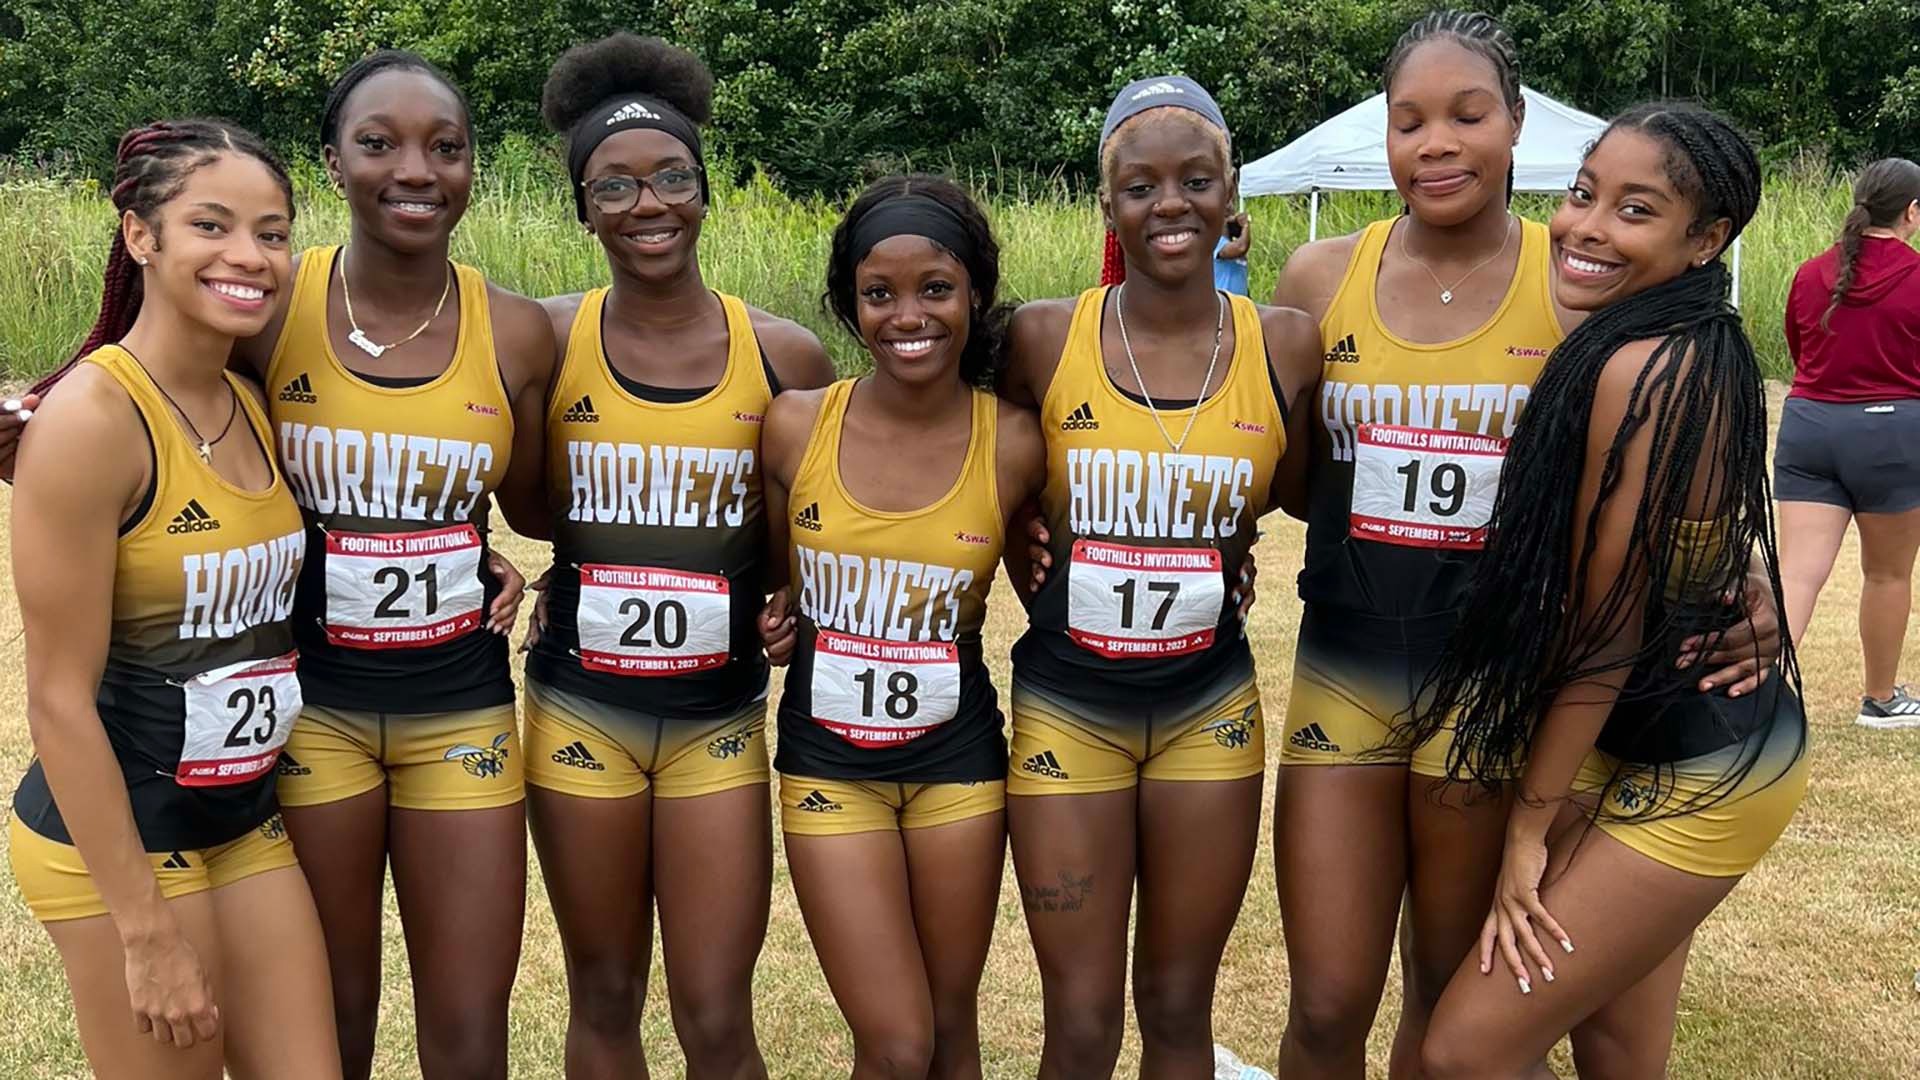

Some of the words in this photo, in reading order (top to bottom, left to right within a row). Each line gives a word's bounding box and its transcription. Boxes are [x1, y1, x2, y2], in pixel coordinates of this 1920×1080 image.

[1325, 351, 1360, 363] adidas
[1516, 348, 1547, 357] SWAC
[279, 391, 317, 404] adidas
[474, 404, 500, 417] SWAC
[562, 412, 600, 424] adidas
[1061, 419, 1099, 431] adidas
[1240, 423, 1265, 434] SWAC
[1371, 427, 1428, 448] FOOTHILLS
[1429, 434, 1503, 453] INVITATIONAL
[281, 421, 493, 522] HORNETS
[567, 440, 755, 528] HORNETS
[1066, 447, 1254, 539] HORNETS
[1397, 459, 1467, 517] 19
[166, 519, 221, 535] adidas
[794, 516, 823, 532] adidas
[1387, 524, 1439, 541] SEPTEMBER
[341, 536, 404, 553] FOOTHILLS
[405, 531, 473, 553] INVITATIONAL
[965, 535, 991, 545] SWAC
[1086, 546, 1142, 567] FOOTHILLS
[1143, 552, 1213, 568] INVITATIONAL
[593, 569, 647, 586] FOOTHILLS
[648, 574, 719, 592] INVITATIONAL
[372, 563, 439, 619] 21
[796, 543, 975, 643] HORNETS
[1113, 578, 1181, 631] 17
[618, 598, 688, 650] 20
[373, 630, 428, 643] SEPTEMBER
[435, 624, 456, 638] 2023
[828, 636, 880, 657] FOOTHILLS
[881, 645, 949, 660] INVITATIONAL
[1107, 640, 1158, 653] SEPTEMBER
[1166, 639, 1188, 650] 2023
[619, 658, 669, 671] SEPTEMBER
[677, 658, 699, 669] 2023
[854, 667, 919, 720] 18
[223, 685, 278, 748] 23
[850, 728, 898, 742] SEPTEMBER
[1289, 735, 1341, 753] adidas
[551, 754, 605, 771] adidas
[1022, 762, 1069, 780] adidas
